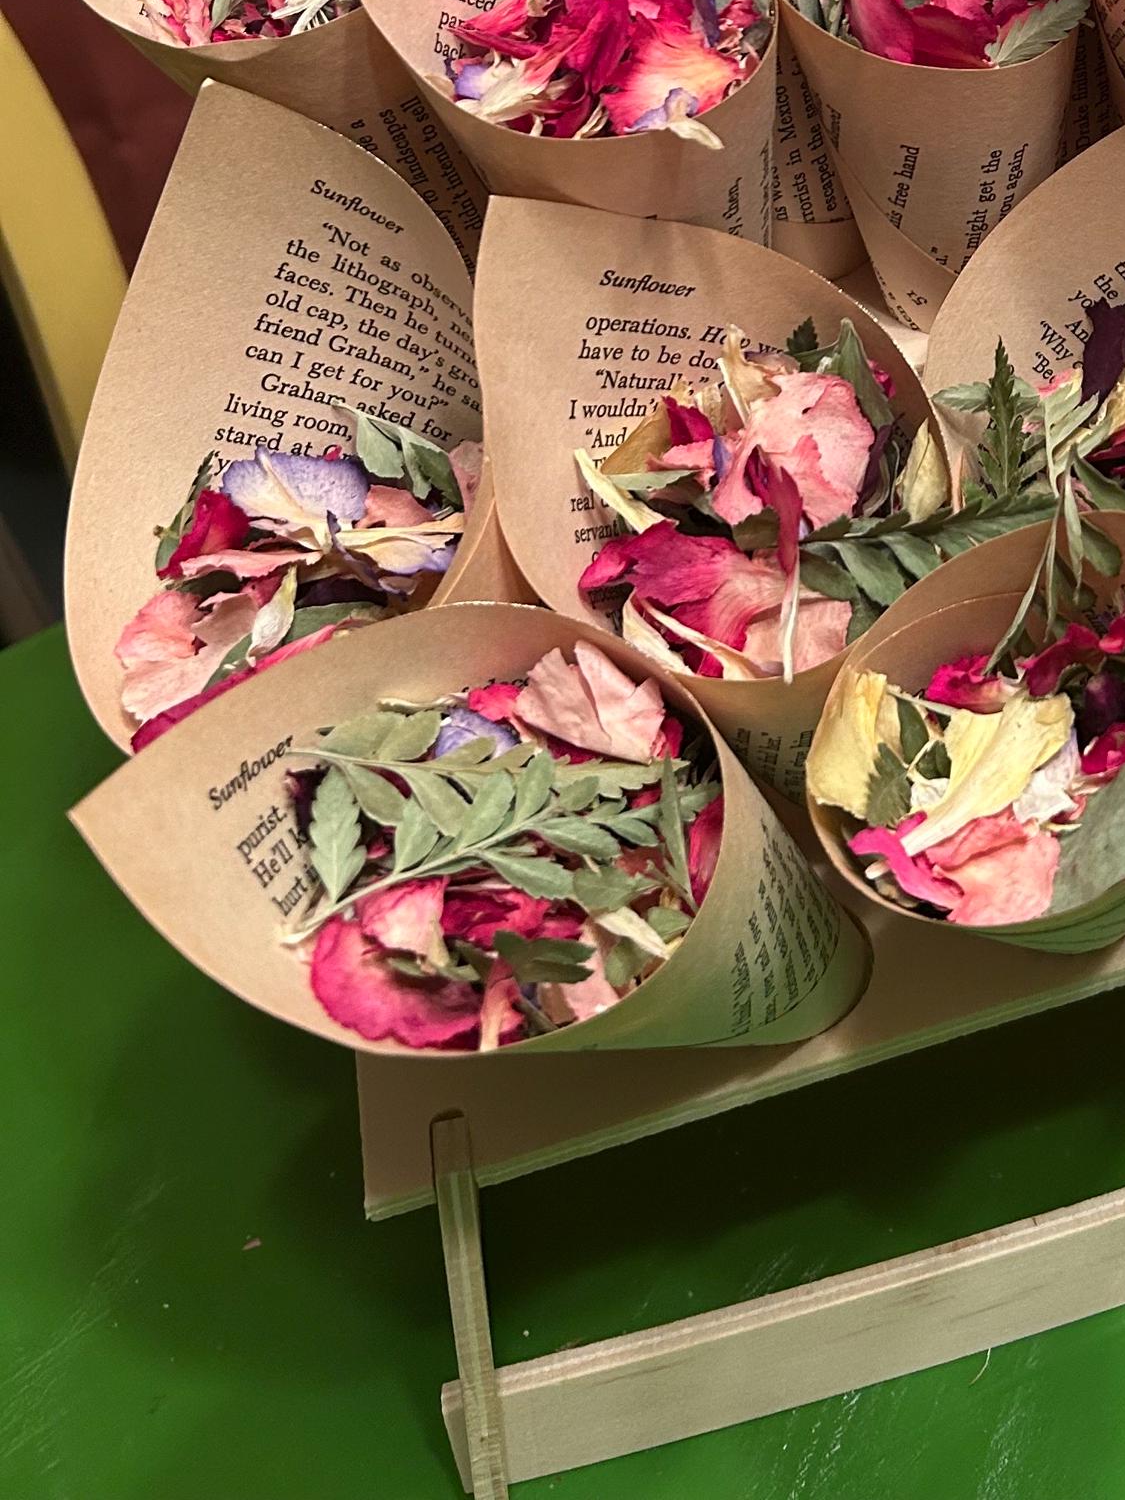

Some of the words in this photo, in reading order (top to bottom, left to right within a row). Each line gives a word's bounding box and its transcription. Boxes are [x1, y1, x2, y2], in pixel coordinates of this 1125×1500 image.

[378, 108, 430, 189] landscapes
[901, 144, 921, 180] hand
[980, 149, 1003, 174] the
[810, 152, 838, 212] escaped
[978, 179, 997, 203] get
[309, 179, 405, 234] Sunflower
[286, 239, 321, 263] the
[330, 253, 440, 322] lithograph,
[379, 255, 401, 272] as
[273, 261, 334, 297] faces.
[345, 284, 398, 321] Then
[598, 269, 696, 298] Sunflower
[253, 313, 324, 347] friend
[265, 289, 303, 313] old
[306, 305, 349, 331] cap,
[357, 318, 391, 342] the
[585, 316, 692, 340] operations.
[245, 345, 284, 365] can
[290, 350, 305, 370] I
[307, 361, 346, 381] get
[348, 368, 384, 392] for
[577, 338, 624, 361] have
[630, 344, 650, 362] to
[656, 344, 682, 365] be
[223, 392, 289, 428] living
[292, 414, 353, 442] room,
[208, 734, 294, 812] Sunflower
